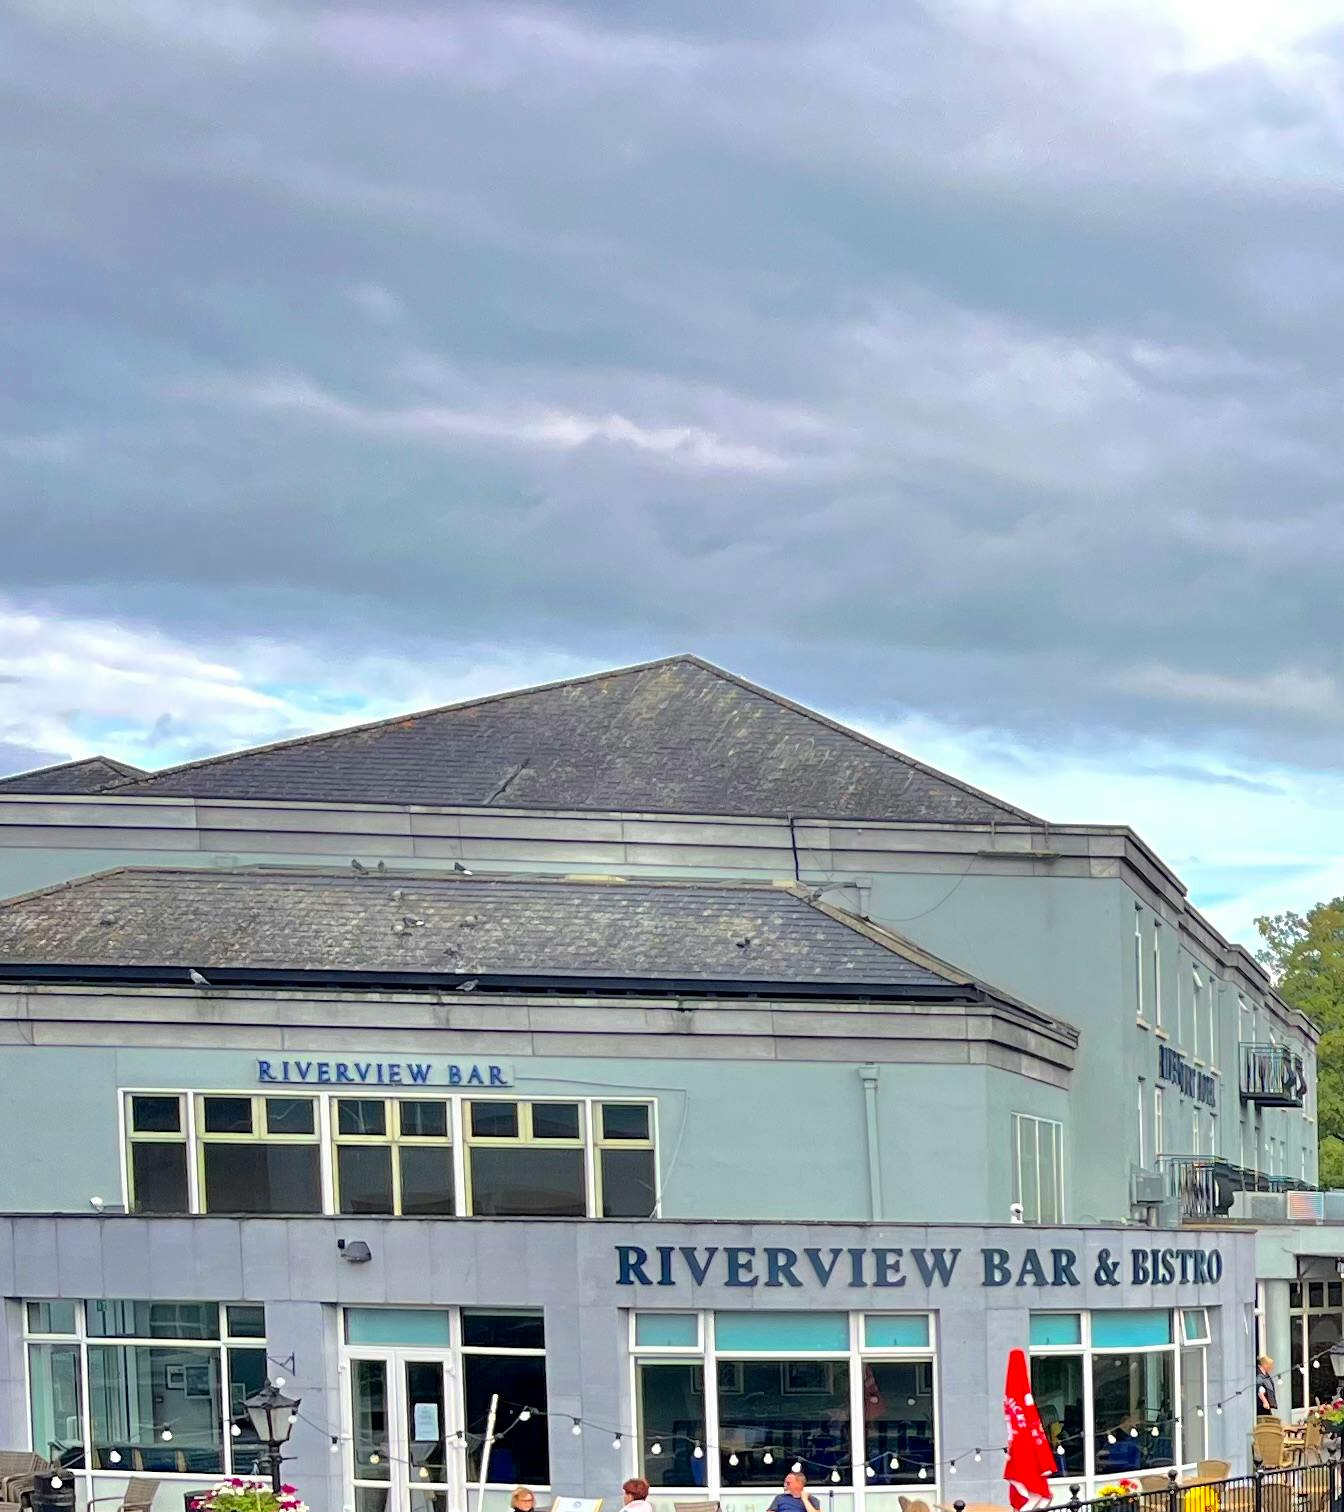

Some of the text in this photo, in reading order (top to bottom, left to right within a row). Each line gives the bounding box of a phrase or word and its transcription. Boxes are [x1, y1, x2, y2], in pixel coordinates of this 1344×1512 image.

[257, 1060, 508, 1085] RIVERVIEW BAR
[615, 1245, 1223, 1287] RIVERVIEW BAR & BISTRO
